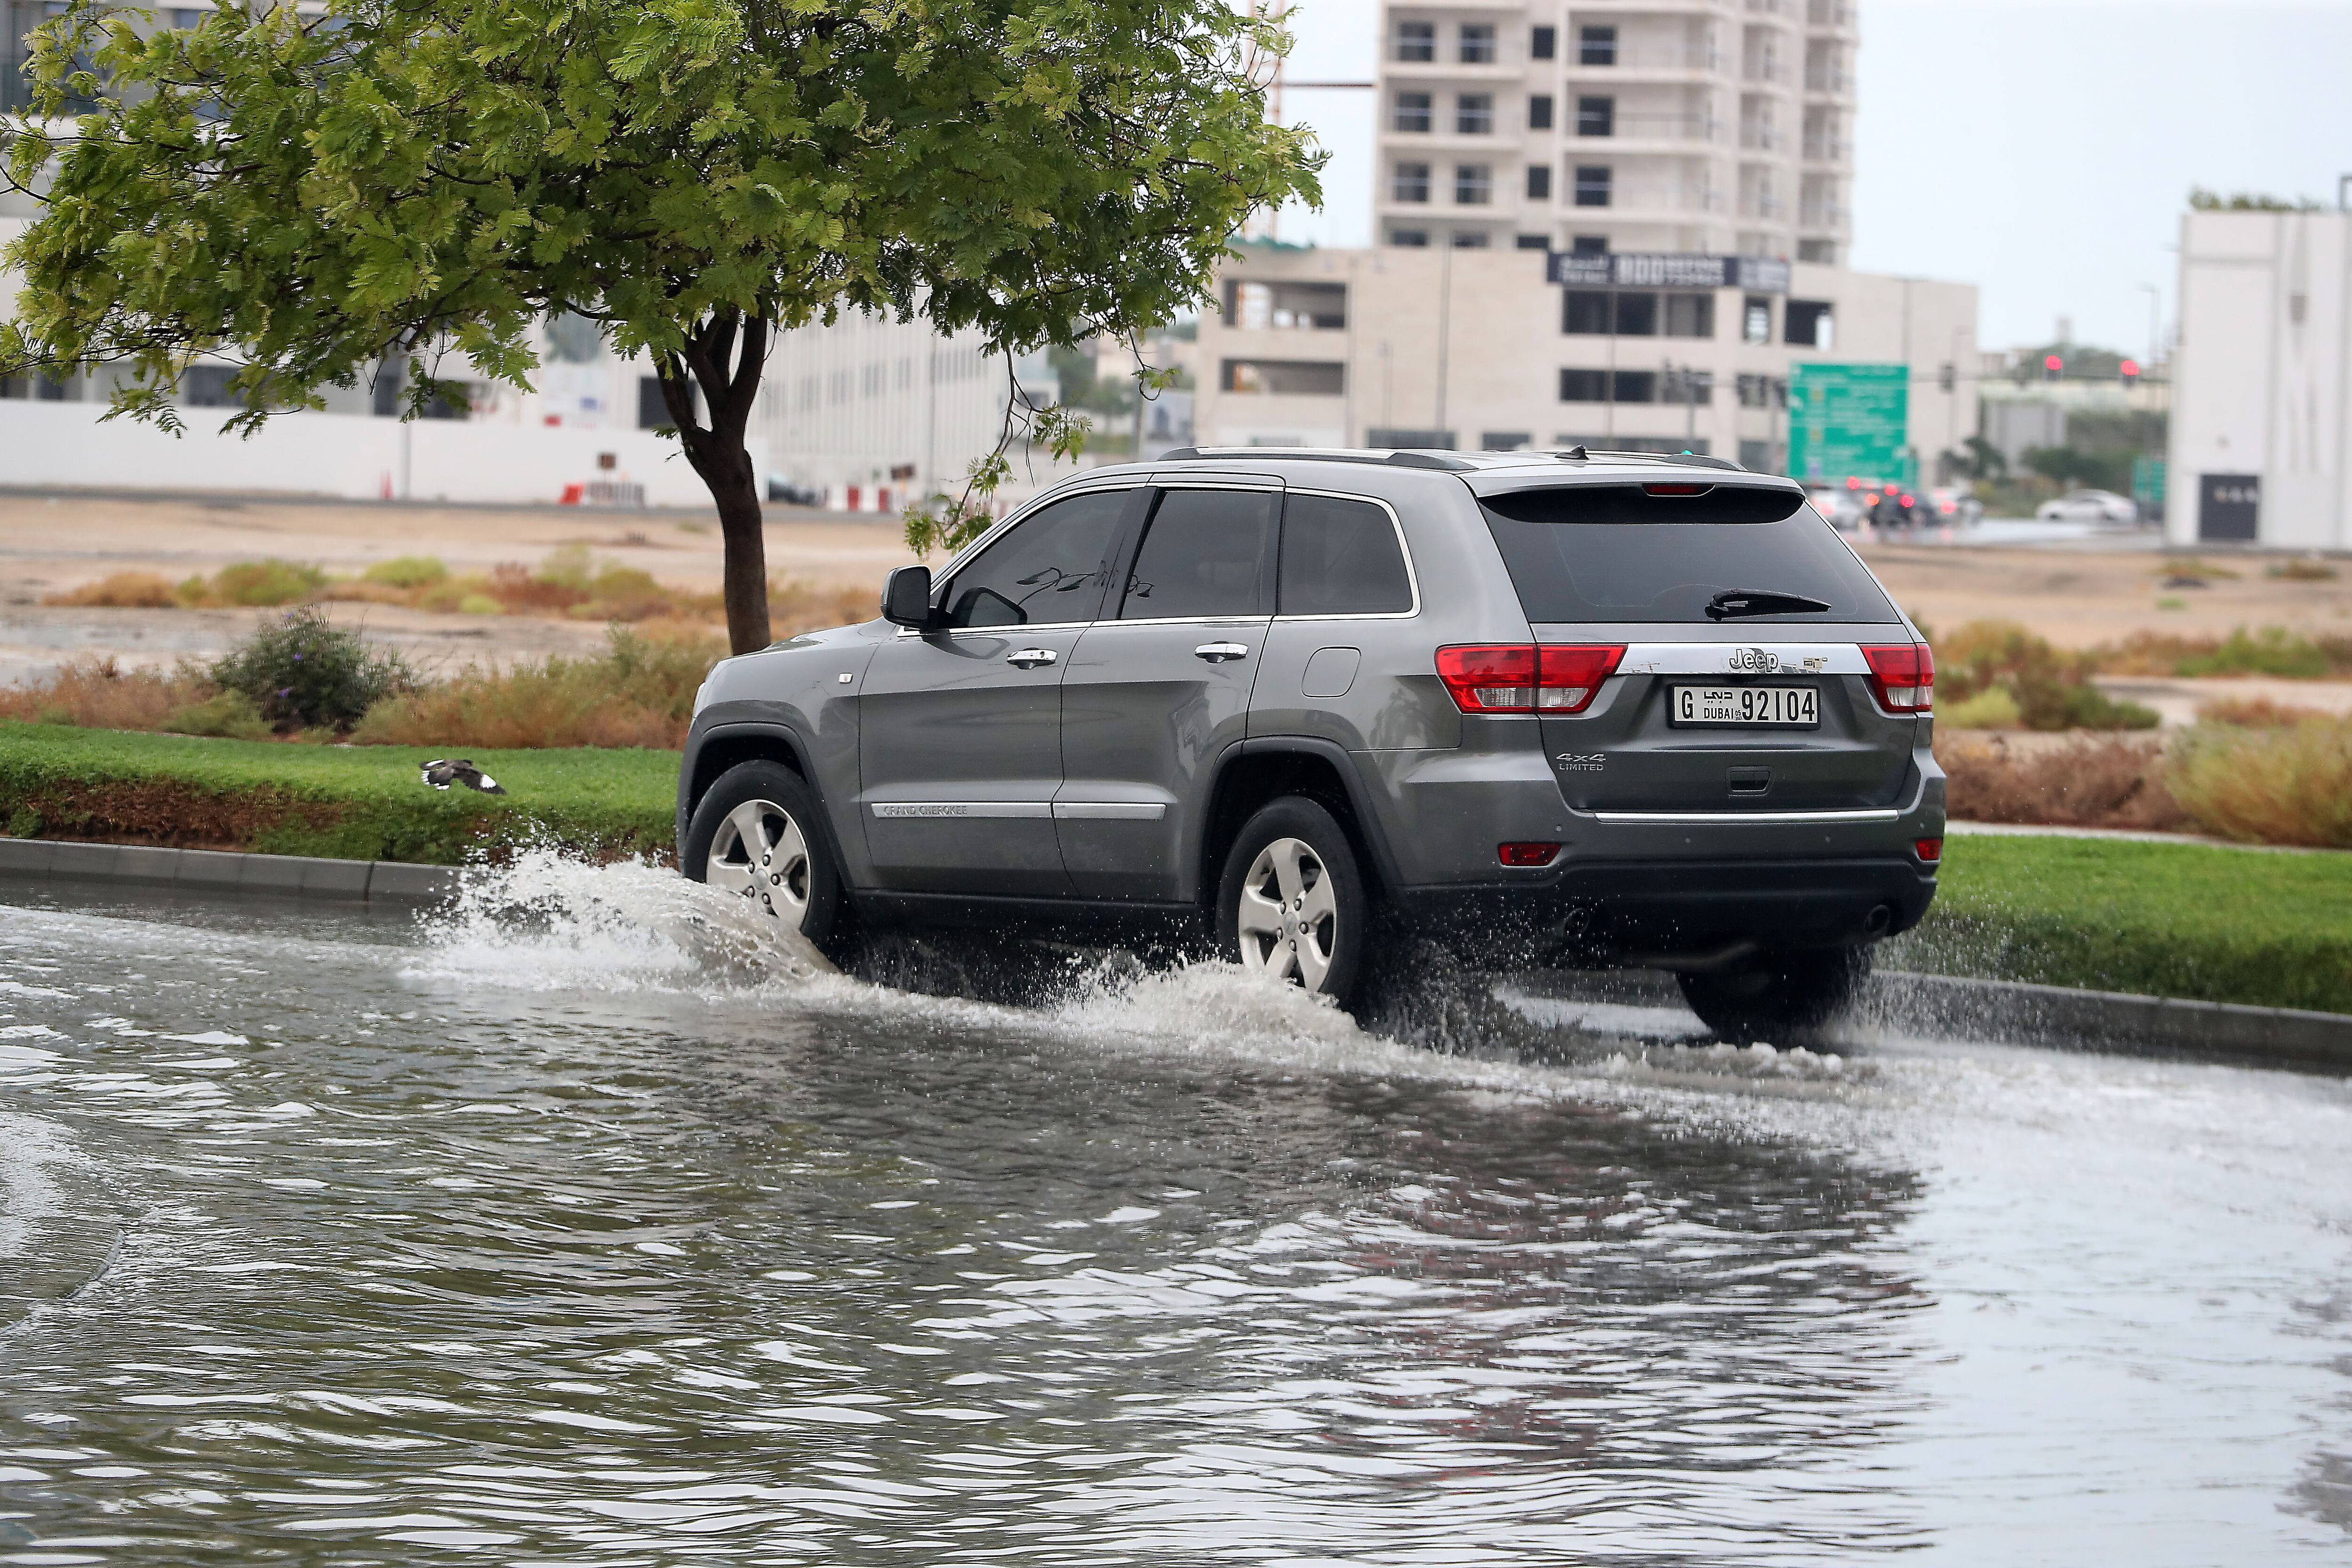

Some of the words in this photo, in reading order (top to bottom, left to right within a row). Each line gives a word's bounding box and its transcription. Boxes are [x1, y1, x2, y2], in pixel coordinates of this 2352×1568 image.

[1729, 649, 1778, 672] Jeep
[1704, 691, 1733, 703] دبي
[1682, 690, 1693, 718] G
[1741, 690, 1815, 721] 92104
[1704, 708, 1734, 719] DUBAI
[1556, 753, 1606, 762] 4x4
[884, 806, 916, 815] GRAND
[919, 806, 968, 815] CHEROKEE
